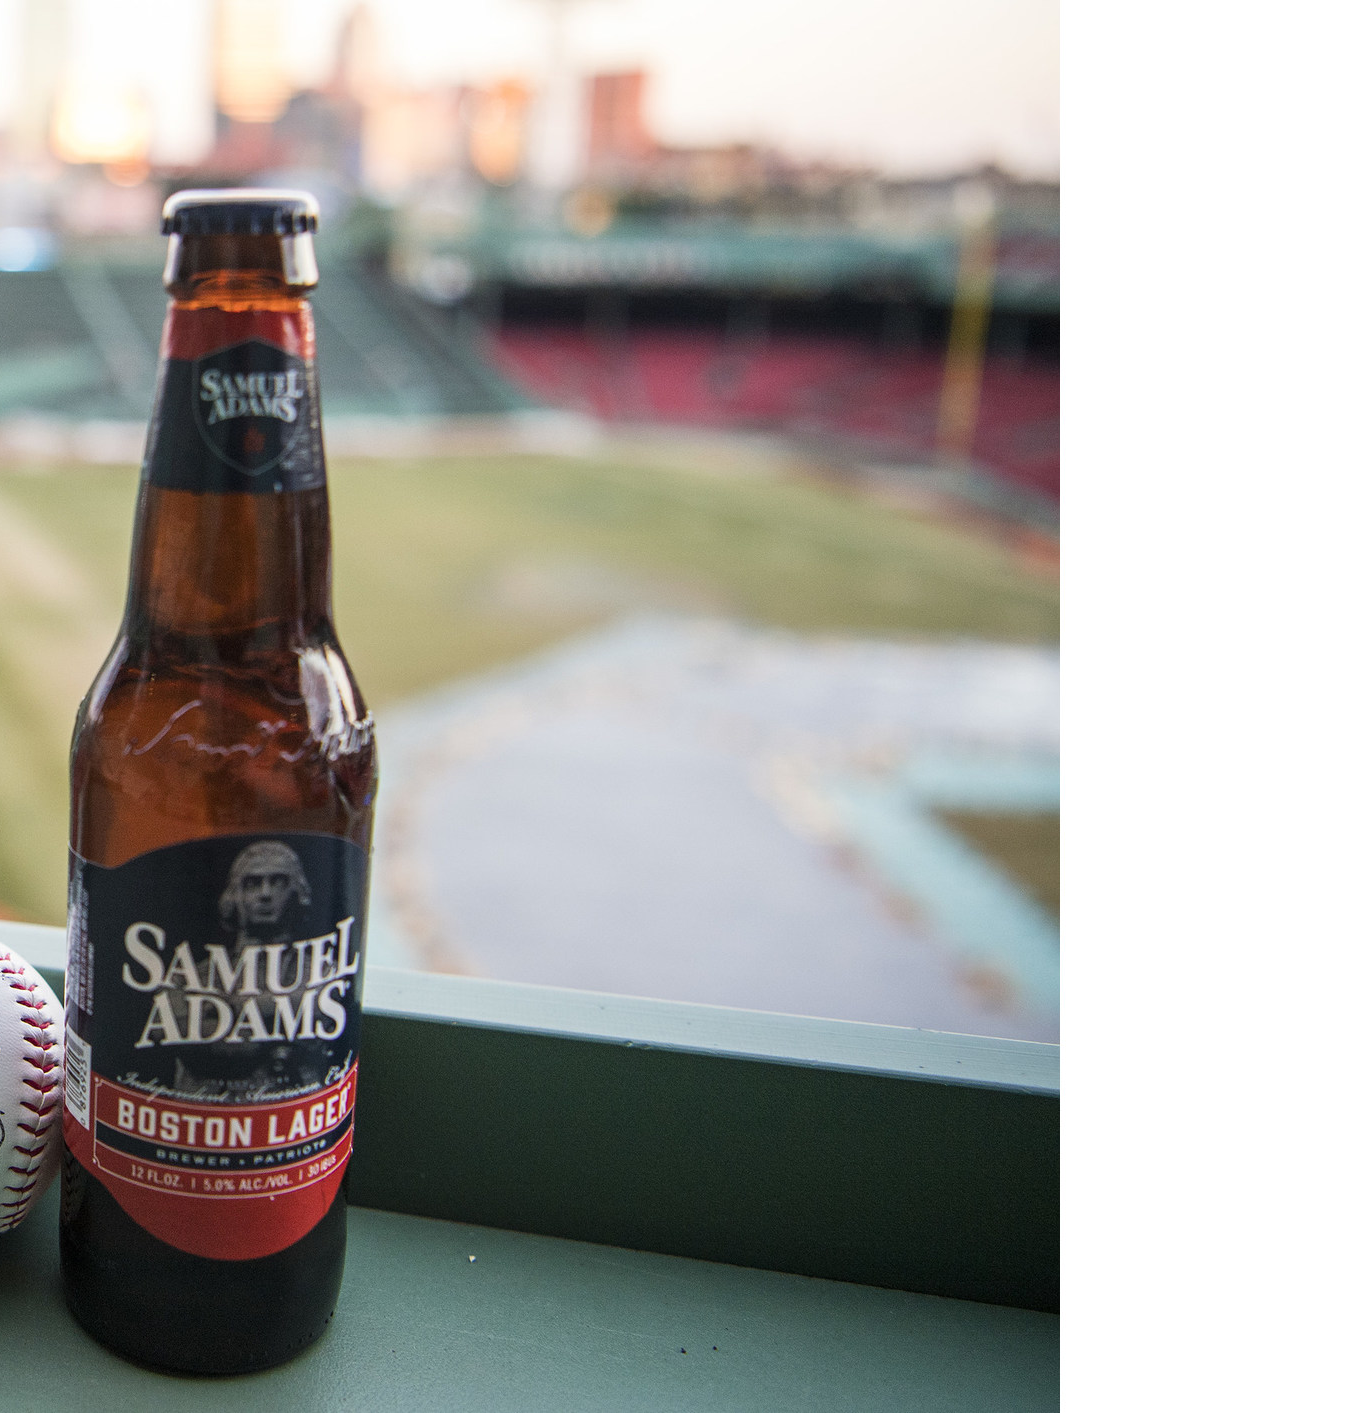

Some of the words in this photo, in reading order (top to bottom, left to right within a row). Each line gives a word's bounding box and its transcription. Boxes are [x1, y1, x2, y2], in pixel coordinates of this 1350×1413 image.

[122, 916, 360, 995] SAMUEL
[134, 980, 350, 1049] ADAMS
[117, 1097, 253, 1147] BOSTON
[268, 1087, 348, 1144] LAGER
[131, 1164, 145, 1180] 12
[203, 1178, 236, 1192] 5.0%
[156, 1149, 231, 1167] BREWER
